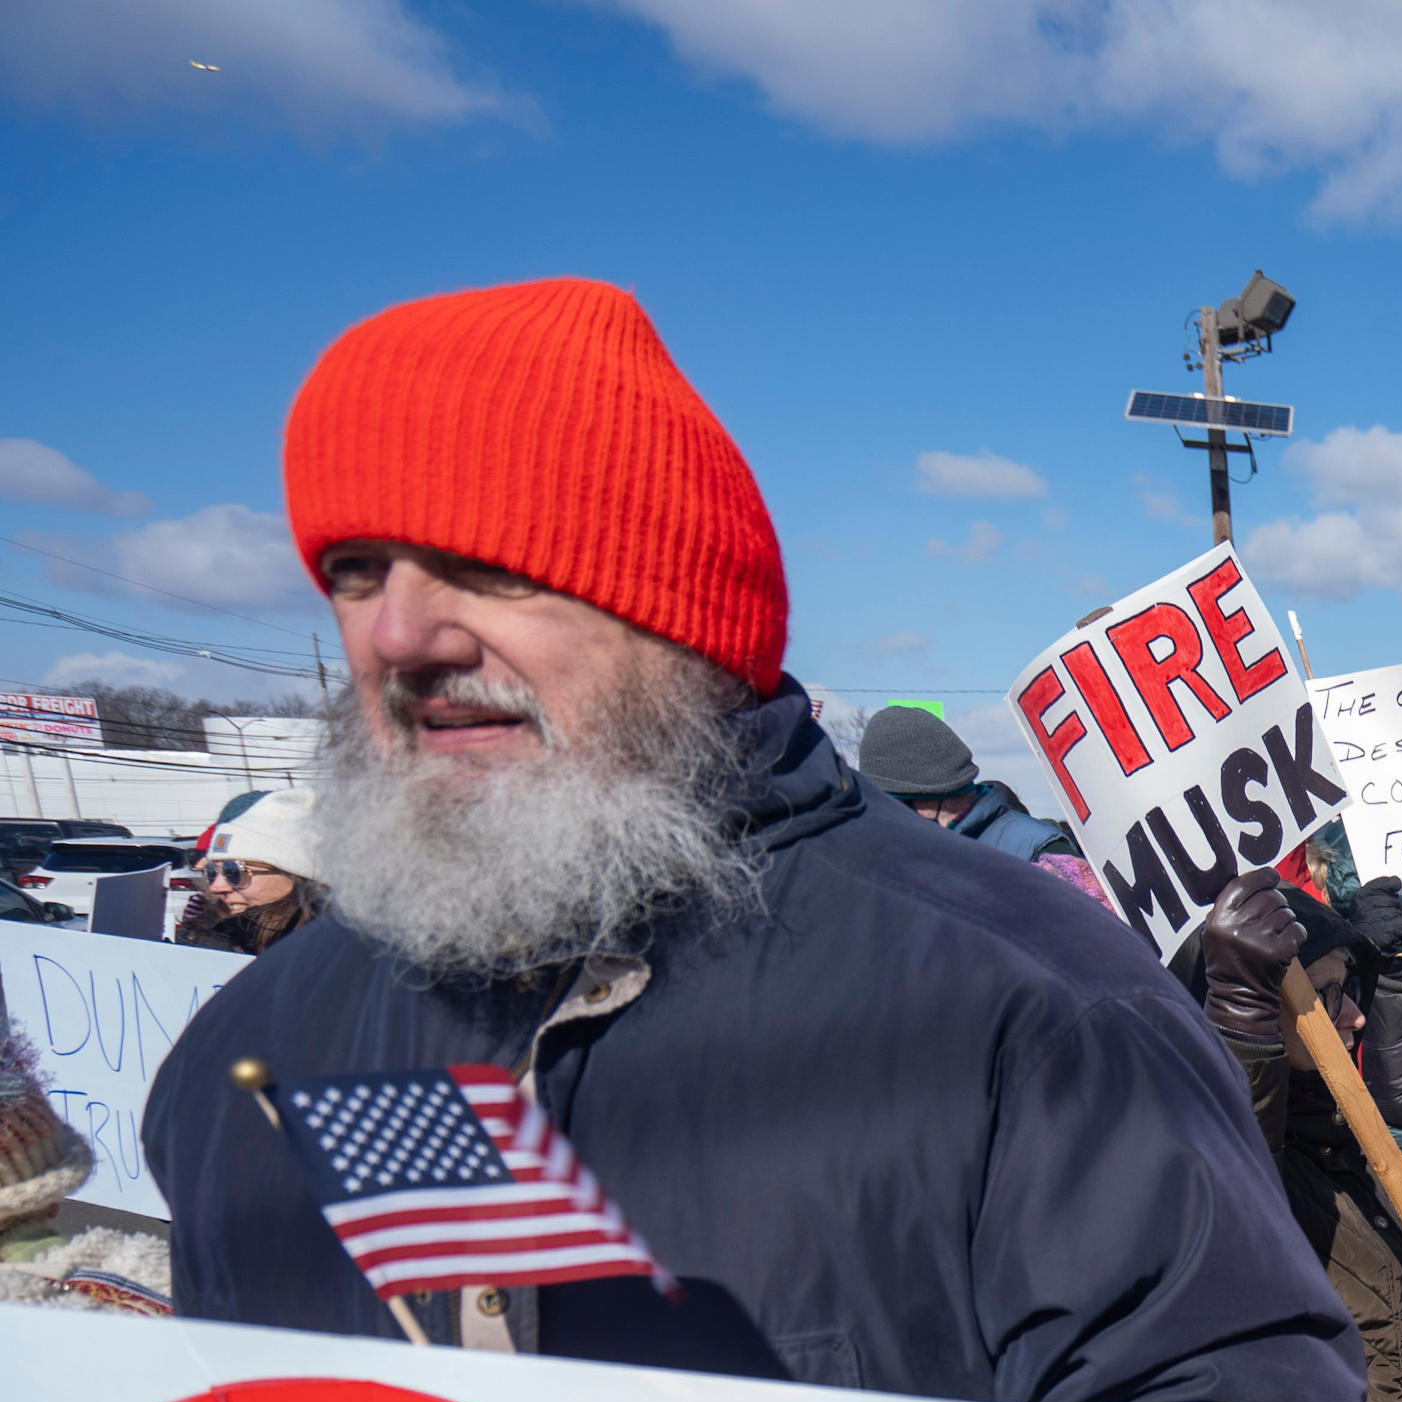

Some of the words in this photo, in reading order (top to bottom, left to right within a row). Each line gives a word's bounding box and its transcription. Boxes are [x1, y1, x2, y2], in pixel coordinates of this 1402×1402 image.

[31, 697, 94, 716] FREIGHT
[1016, 554, 1290, 826] FIRE
[1312, 680, 1377, 720] THE
[1102, 701, 1348, 959] MUSK
[33, 952, 227, 1083] DUM
[48, 1089, 146, 1193] TRU
